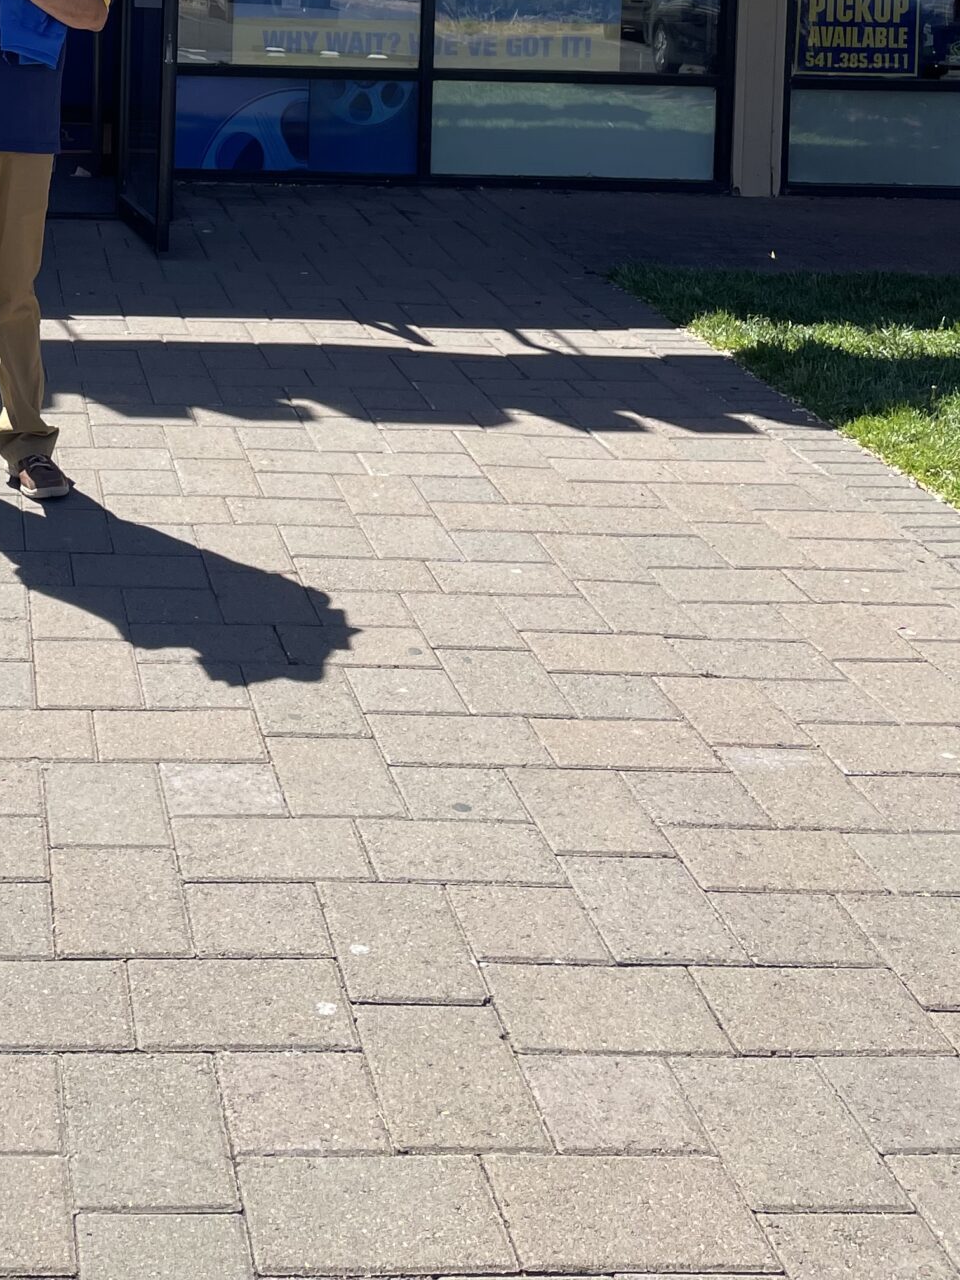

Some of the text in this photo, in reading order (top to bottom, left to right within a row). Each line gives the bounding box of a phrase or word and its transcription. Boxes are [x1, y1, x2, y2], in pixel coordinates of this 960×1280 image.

[262, 30, 319, 54] WHY
[325, 31, 401, 56] WAIT?
[506, 35, 553, 57] GOT
[561, 36, 592, 58] IT!
[808, 26, 908, 49] AVAILABLE
[805, 52, 908, 70] 541.385.9111
